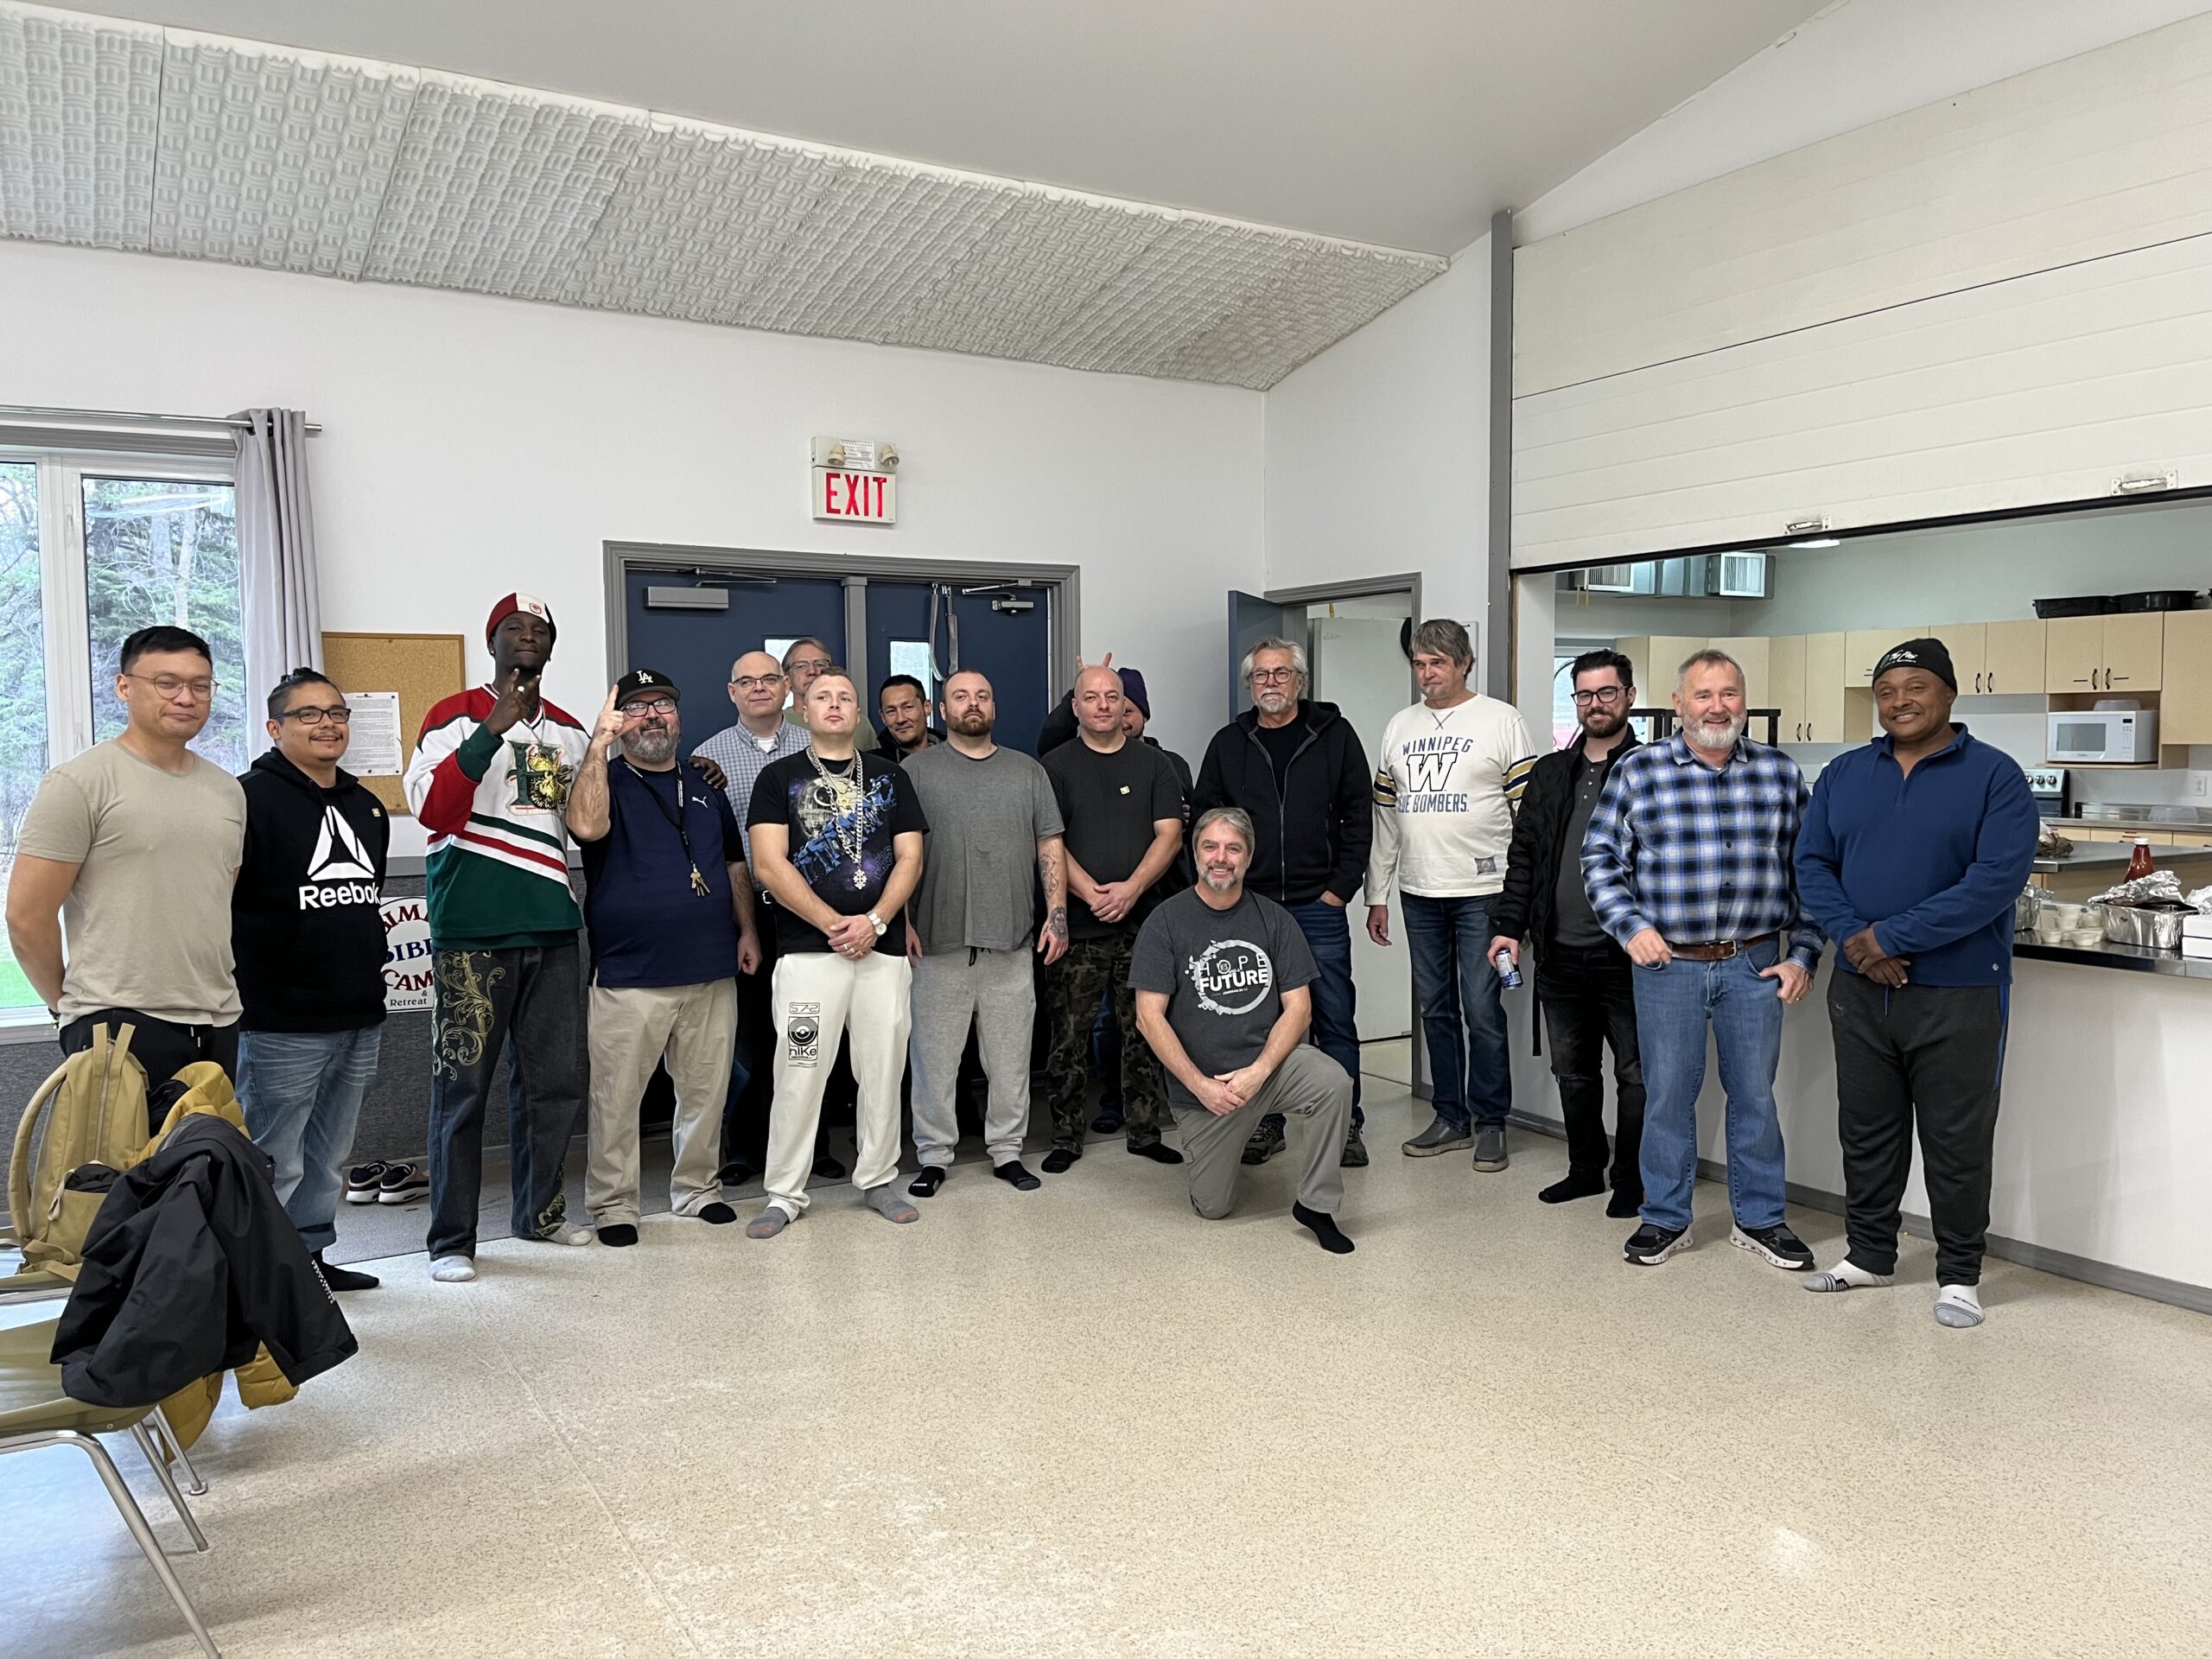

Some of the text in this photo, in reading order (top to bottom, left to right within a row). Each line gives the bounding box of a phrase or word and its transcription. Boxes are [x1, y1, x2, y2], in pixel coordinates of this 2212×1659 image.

[826, 472, 887, 518] EXIT
[637, 670, 653, 683] LA
[1402, 736, 1473, 755] WINNIPEG
[1406, 752, 1458, 792] W
[299, 881, 381, 910] Reebok
[380, 969, 434, 991] CAM
[1199, 969, 1268, 993] FUTURE
[391, 998, 427, 1007] Retreat
